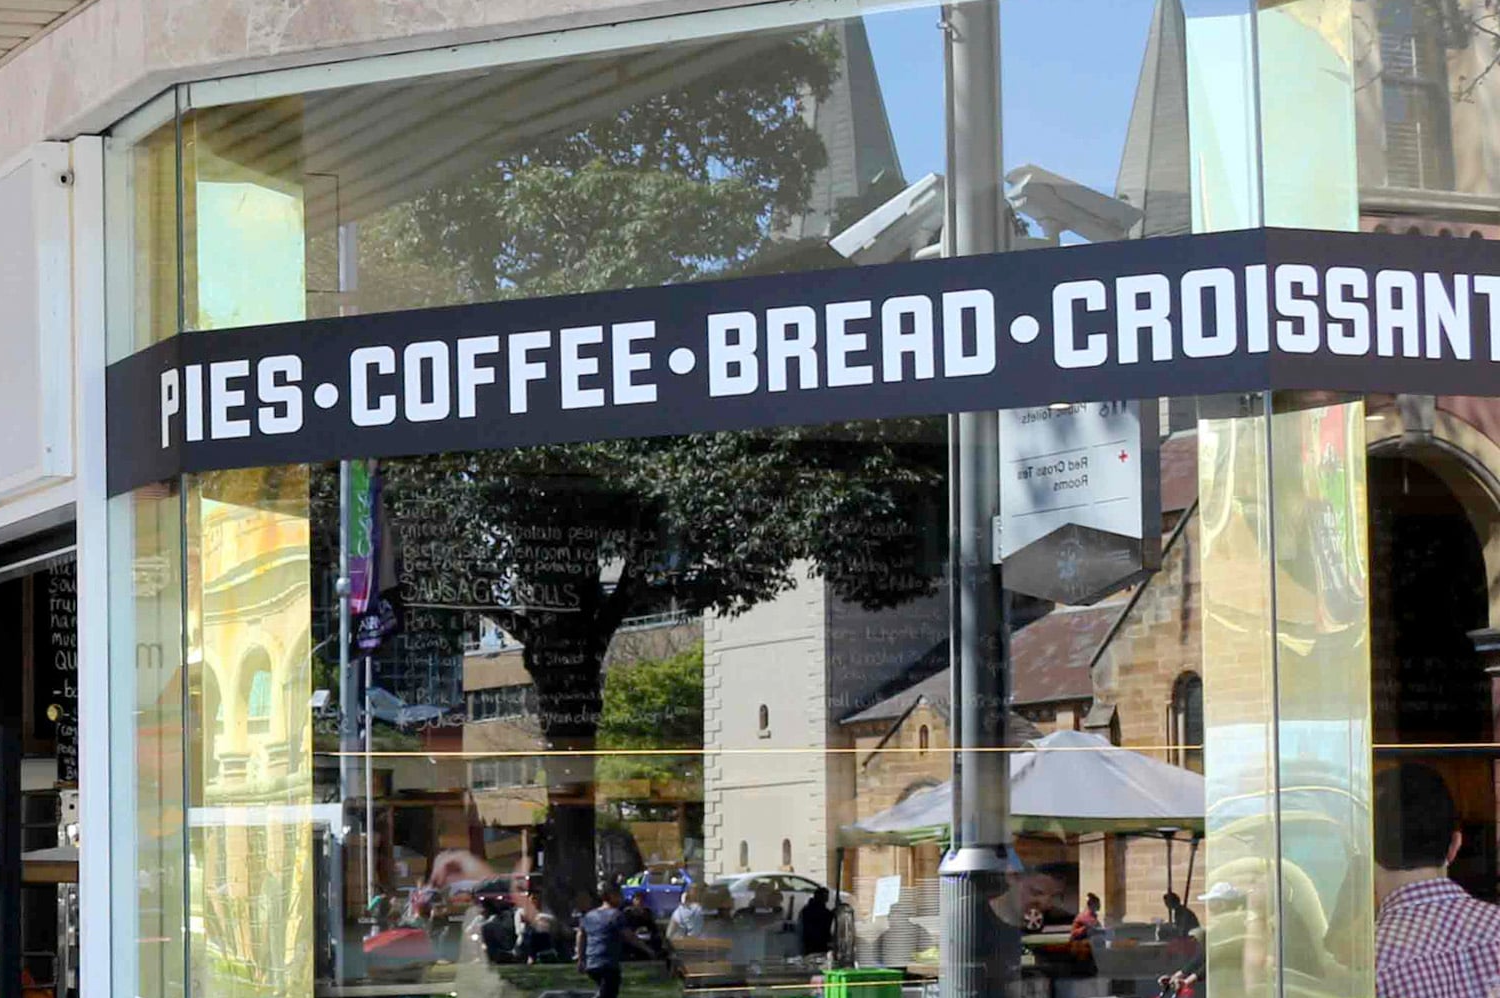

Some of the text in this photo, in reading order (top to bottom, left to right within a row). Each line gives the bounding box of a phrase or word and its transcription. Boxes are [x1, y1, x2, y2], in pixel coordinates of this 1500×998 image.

[161, 353, 303, 449] PIES
[350, 320, 658, 427] COFFEE
[707, 289, 996, 398] BREAD
